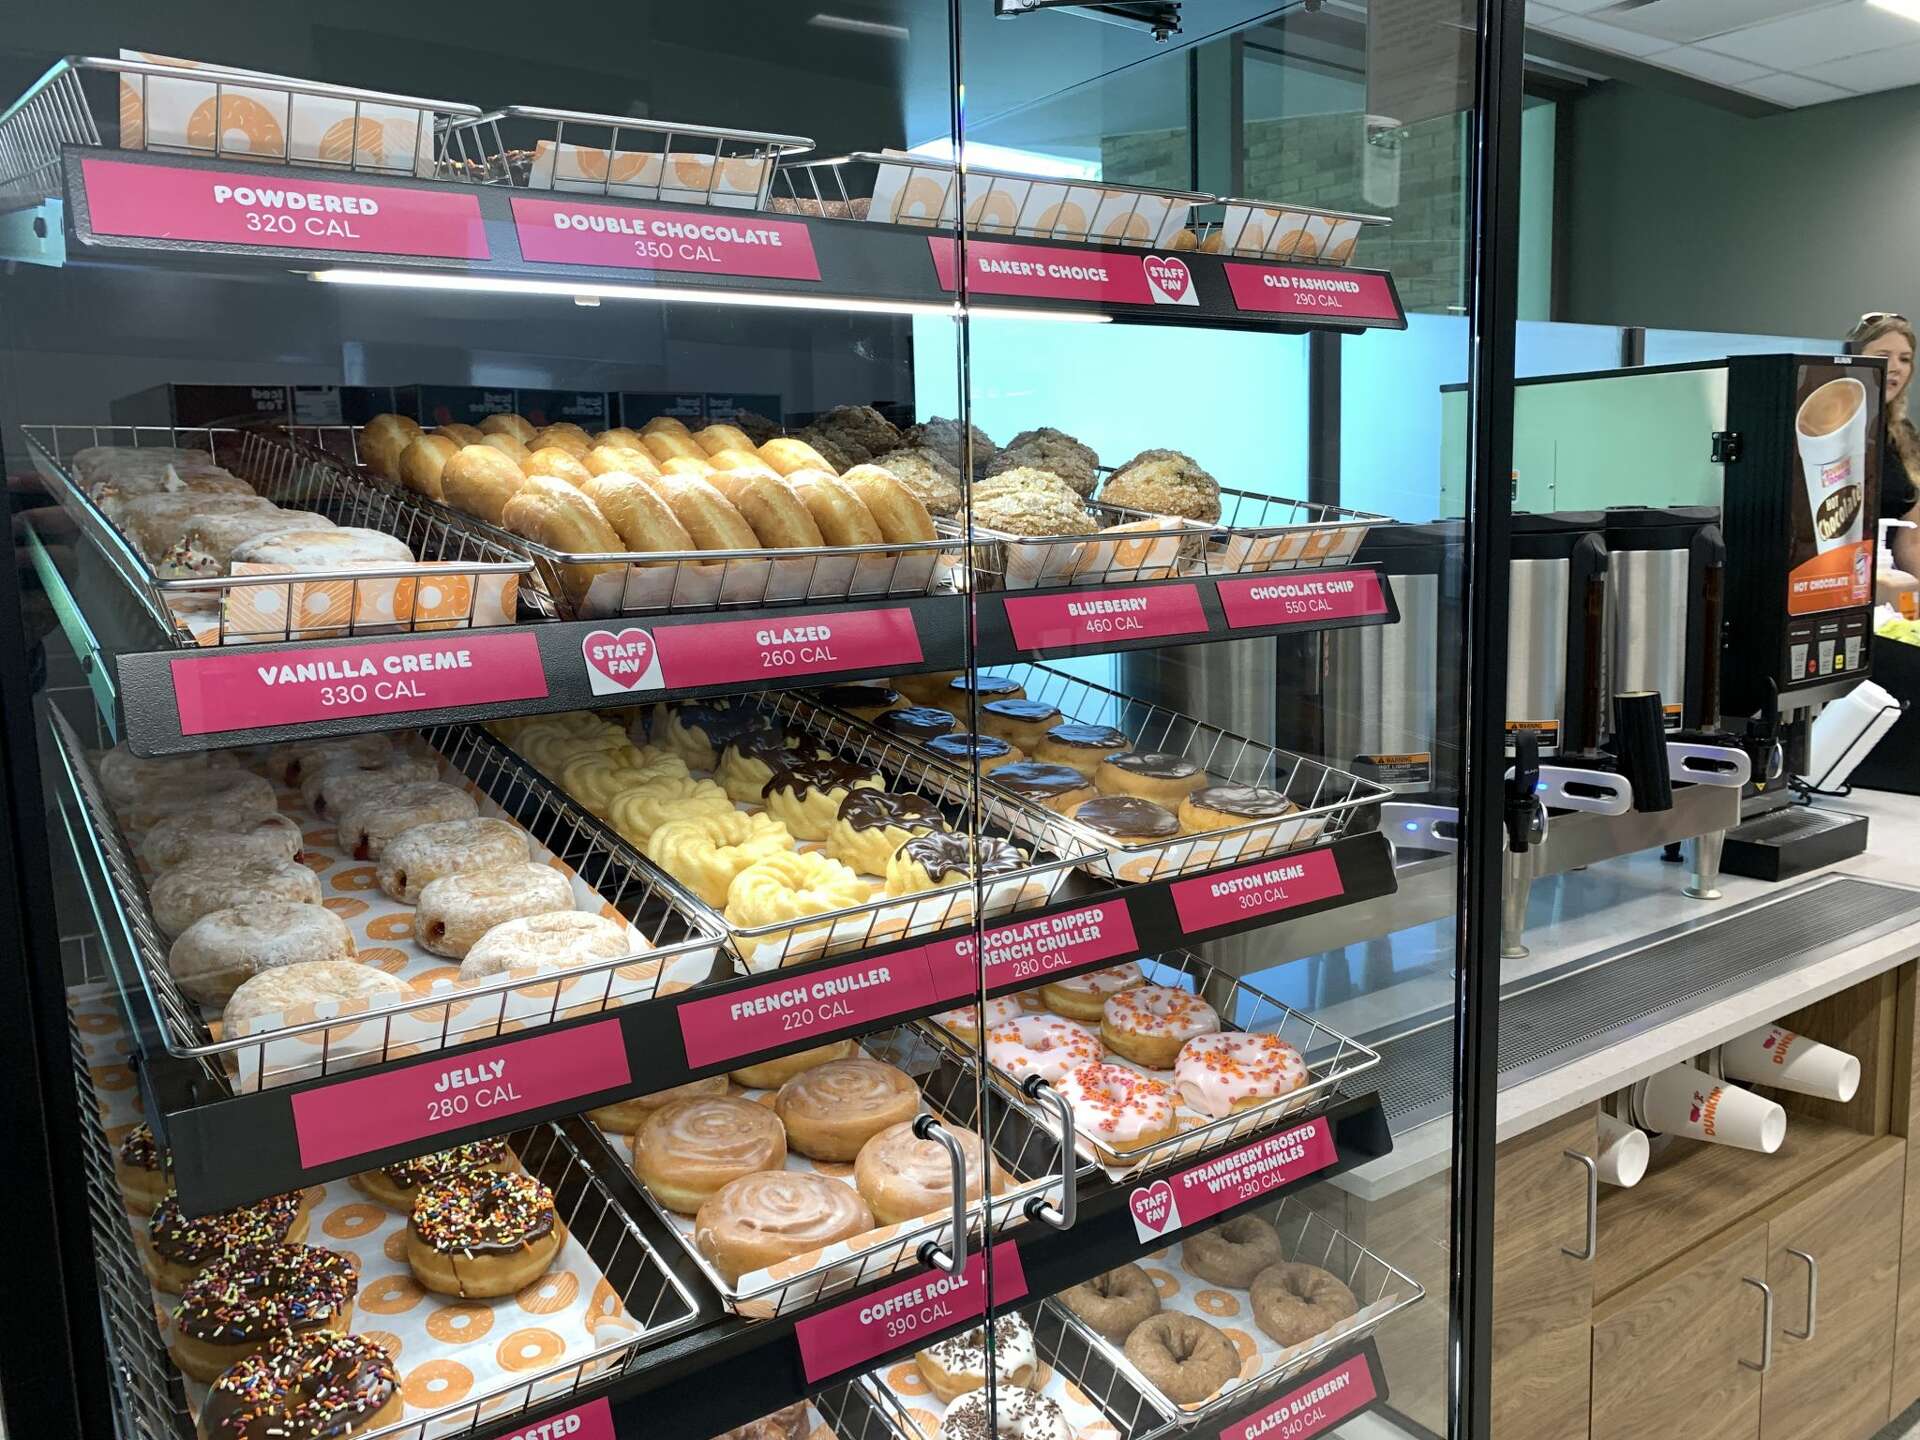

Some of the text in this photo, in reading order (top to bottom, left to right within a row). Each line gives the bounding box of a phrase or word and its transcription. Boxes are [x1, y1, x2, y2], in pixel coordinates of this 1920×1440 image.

[214, 185, 379, 216] POWDERED
[246, 213, 360, 238] 320 CAL
[553, 213, 782, 247] DOUBLE CHOCOLATE
[634, 241, 721, 262] 350 CAL
[978, 258, 1109, 282] BAKER'S CHOICE
[1150, 266, 1184, 280] STAFF
[1161, 278, 1182, 291] FAV
[1263, 274, 1360, 293] OLD FASHIONED
[1294, 292, 1342, 308] 290 CAL
[1818, 486, 1862, 540] Chocolate
[1250, 580, 1354, 600] CHOCOLATE CHIP
[1793, 576, 1849, 593] HOT CHOCOLATE
[1067, 597, 1148, 616] BLUEBERRY
[1285, 598, 1333, 614] 550 CAL
[756, 625, 831, 646] GLAZED
[1086, 616, 1143, 633] 460 CAL
[592, 641, 647, 660] STAFF
[761, 645, 837, 667] 260 CAL
[258, 650, 472, 686] VANILLA CREME
[608, 658, 640, 675] FAV
[320, 679, 426, 706] 330 CAL
[1210, 864, 1304, 897] BOSTON KREME
[1239, 887, 1288, 909] 300 CAL
[1052, 908, 1104, 931] DIPPED
[1036, 925, 1101, 953] CRULLER
[1013, 951, 1071, 977] 280 CAL
[731, 967, 891, 1021] FRENCH CRULLER
[782, 999, 854, 1031] 220 CAL
[434, 1059, 505, 1092] JELLY
[427, 1083, 522, 1121] 280 CAL
[1183, 1125, 1316, 1188] STRAWBERRY FROSTED
[1207, 1145, 1305, 1194] WITH SPRINKLES
[1238, 1171, 1286, 1199] 290 CAL
[1135, 1191, 1168, 1213] STAFF
[1146, 1207, 1166, 1223] FAV
[859, 1275, 969, 1325] COFFEE ROLL
[886, 1301, 953, 1338] 390 CAL
[1245, 1371, 1350, 1440] GLAZED BLUEBERRY
[510, 1414, 581, 1440] STED
[1282, 1407, 1326, 1439] 340 CAL
